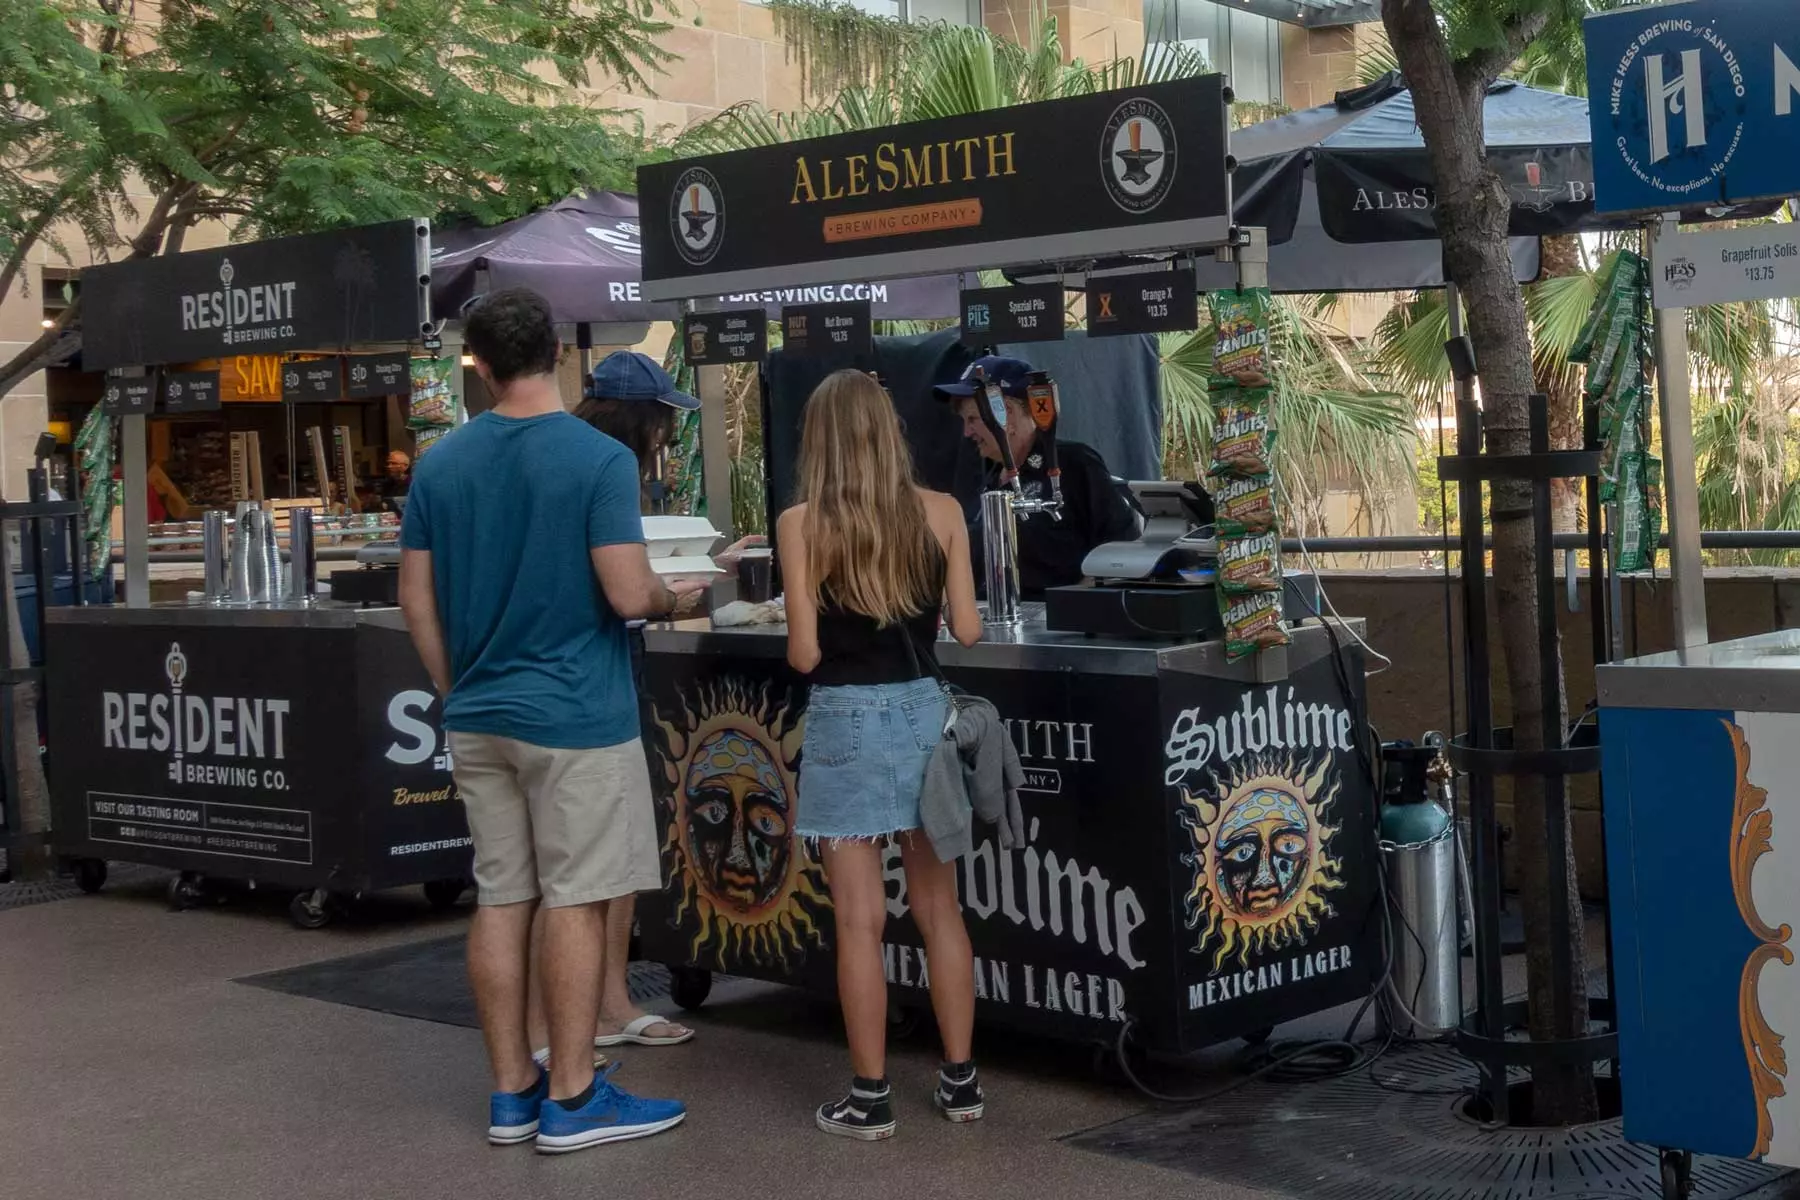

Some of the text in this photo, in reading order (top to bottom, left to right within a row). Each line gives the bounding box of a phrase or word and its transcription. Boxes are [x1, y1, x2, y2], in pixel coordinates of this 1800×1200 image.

[1610, 77, 1624, 115] MIKE
[1617, 42, 1639, 77] HESS
[1638, 19, 1692, 46] BREWING
[1703, 27, 1727, 53] SAN
[1723, 49, 1745, 97] DIEGO
[1617, 122, 1744, 195] Great beer. No exceptions. No excuses.
[1352, 187, 1437, 211] ALES
[836, 207, 967, 235] BREWING COMPANY
[1721, 243, 1798, 264] Grapefruit Solis
[1665, 262, 1696, 281] HESS
[1745, 266, 1774, 281] $13.75
[1142, 287, 1173, 302] Orange X
[181, 281, 297, 331] RESIDENT
[1100, 296, 1113, 317] X
[1147, 304, 1168, 317] $13.75
[788, 316, 807, 329] NUT
[968, 310, 990, 328] PILS
[1018, 315, 1037, 328] $13.75
[233, 325, 297, 343] BREWING CO.
[1214, 328, 1266, 357] EANUTS
[236, 355, 279, 395] SAV
[1037, 400, 1048, 413] X
[1213, 415, 1269, 443] EANUTS
[103, 691, 290, 759] RESIDENT
[1165, 685, 1355, 786] Sublime
[186, 764, 290, 790] BREWING CO.
[393, 785, 452, 806] Brewed
[95, 801, 199, 823] VISIT OUR TASTING ROOM
[391, 837, 473, 856] RESIDENTBREW
[1189, 944, 1353, 1011] MEXICAN LAGER
[1023, 964, 1128, 1023] LAGER
